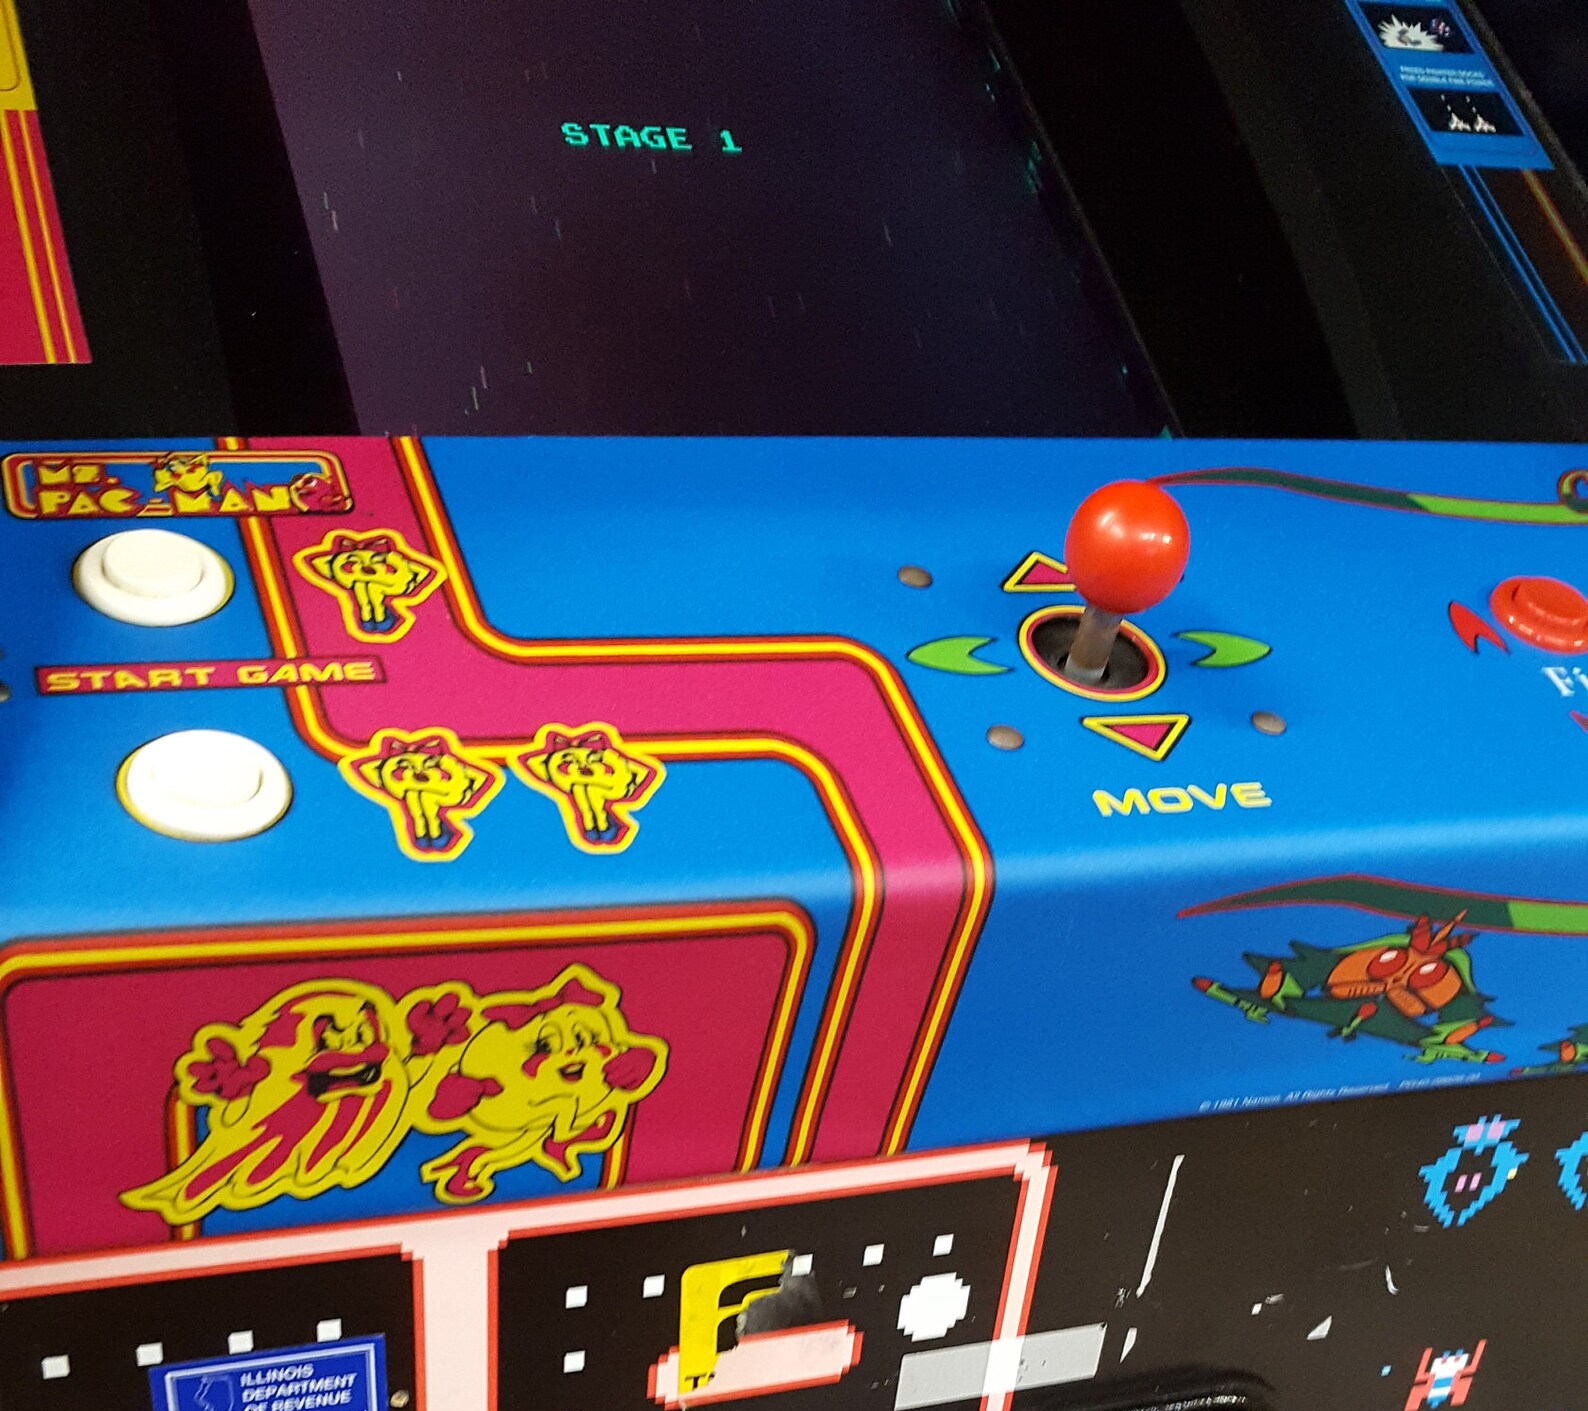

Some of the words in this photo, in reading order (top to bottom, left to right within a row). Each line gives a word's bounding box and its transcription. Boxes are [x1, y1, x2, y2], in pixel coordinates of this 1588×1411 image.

[561, 122, 692, 150] STAGE
[720, 129, 743, 152] 1
[38, 485, 291, 517] PAC-MAN
[47, 667, 215, 692] START
[236, 662, 376, 684] GAME
[1092, 782, 1272, 817] MOVE
[241, 1363, 314, 1387] ILLINOIS
[242, 1372, 357, 1403] DEPARTMENT
